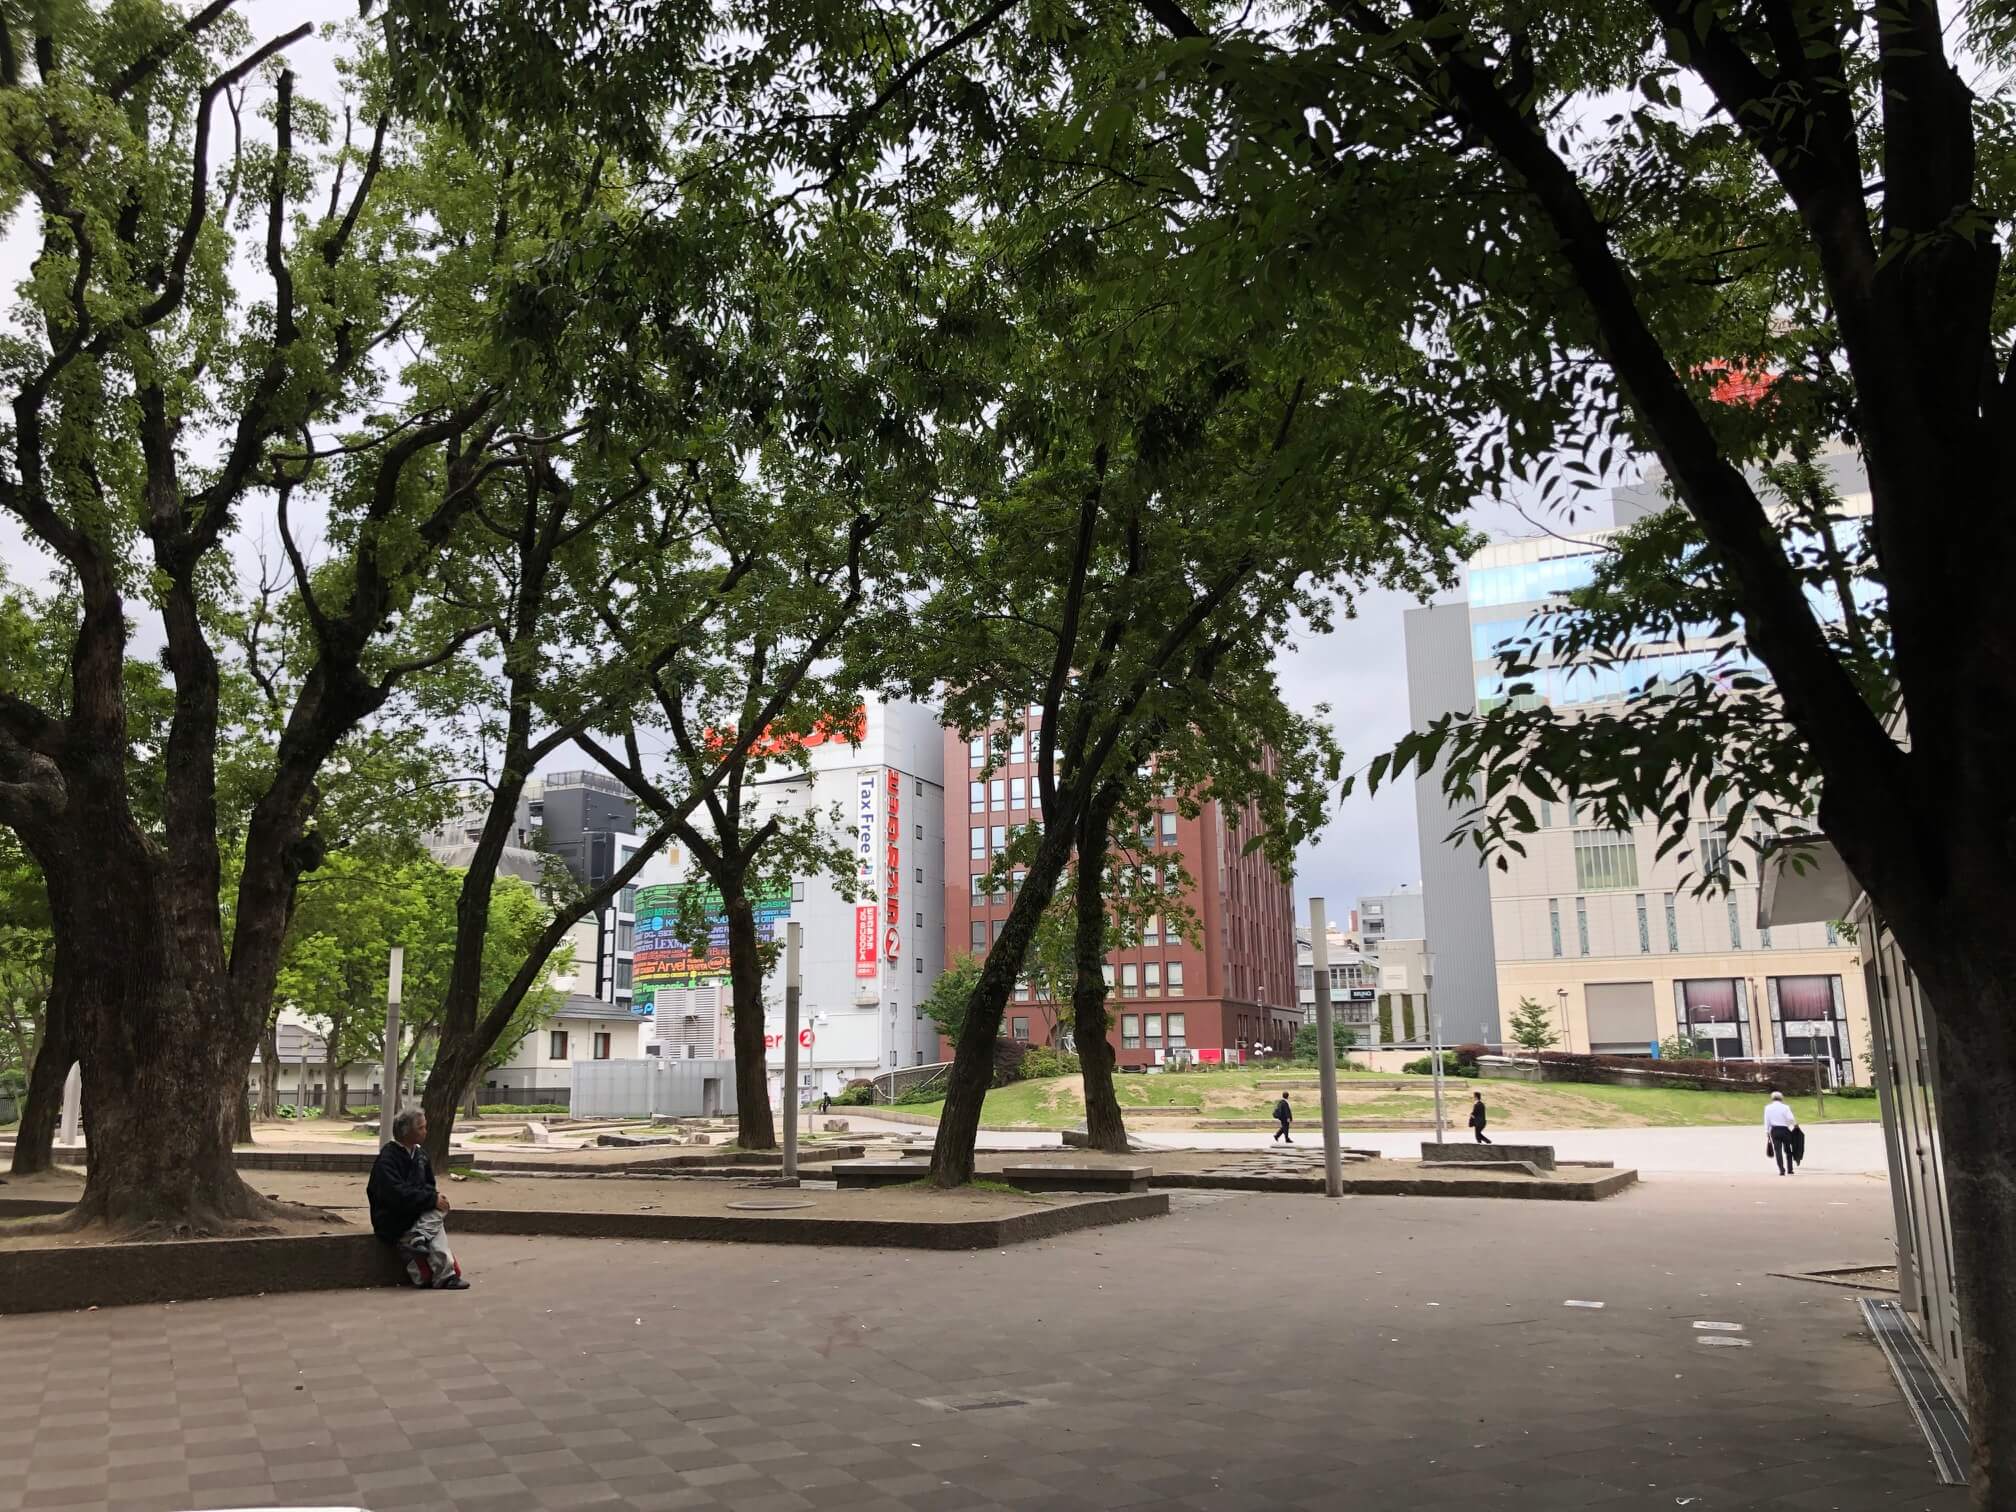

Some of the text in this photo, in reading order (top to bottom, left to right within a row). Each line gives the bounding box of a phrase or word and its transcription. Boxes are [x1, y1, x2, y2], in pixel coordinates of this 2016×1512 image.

[861, 777, 874, 853] Tax Free
[657, 959, 686, 972] Arvel
